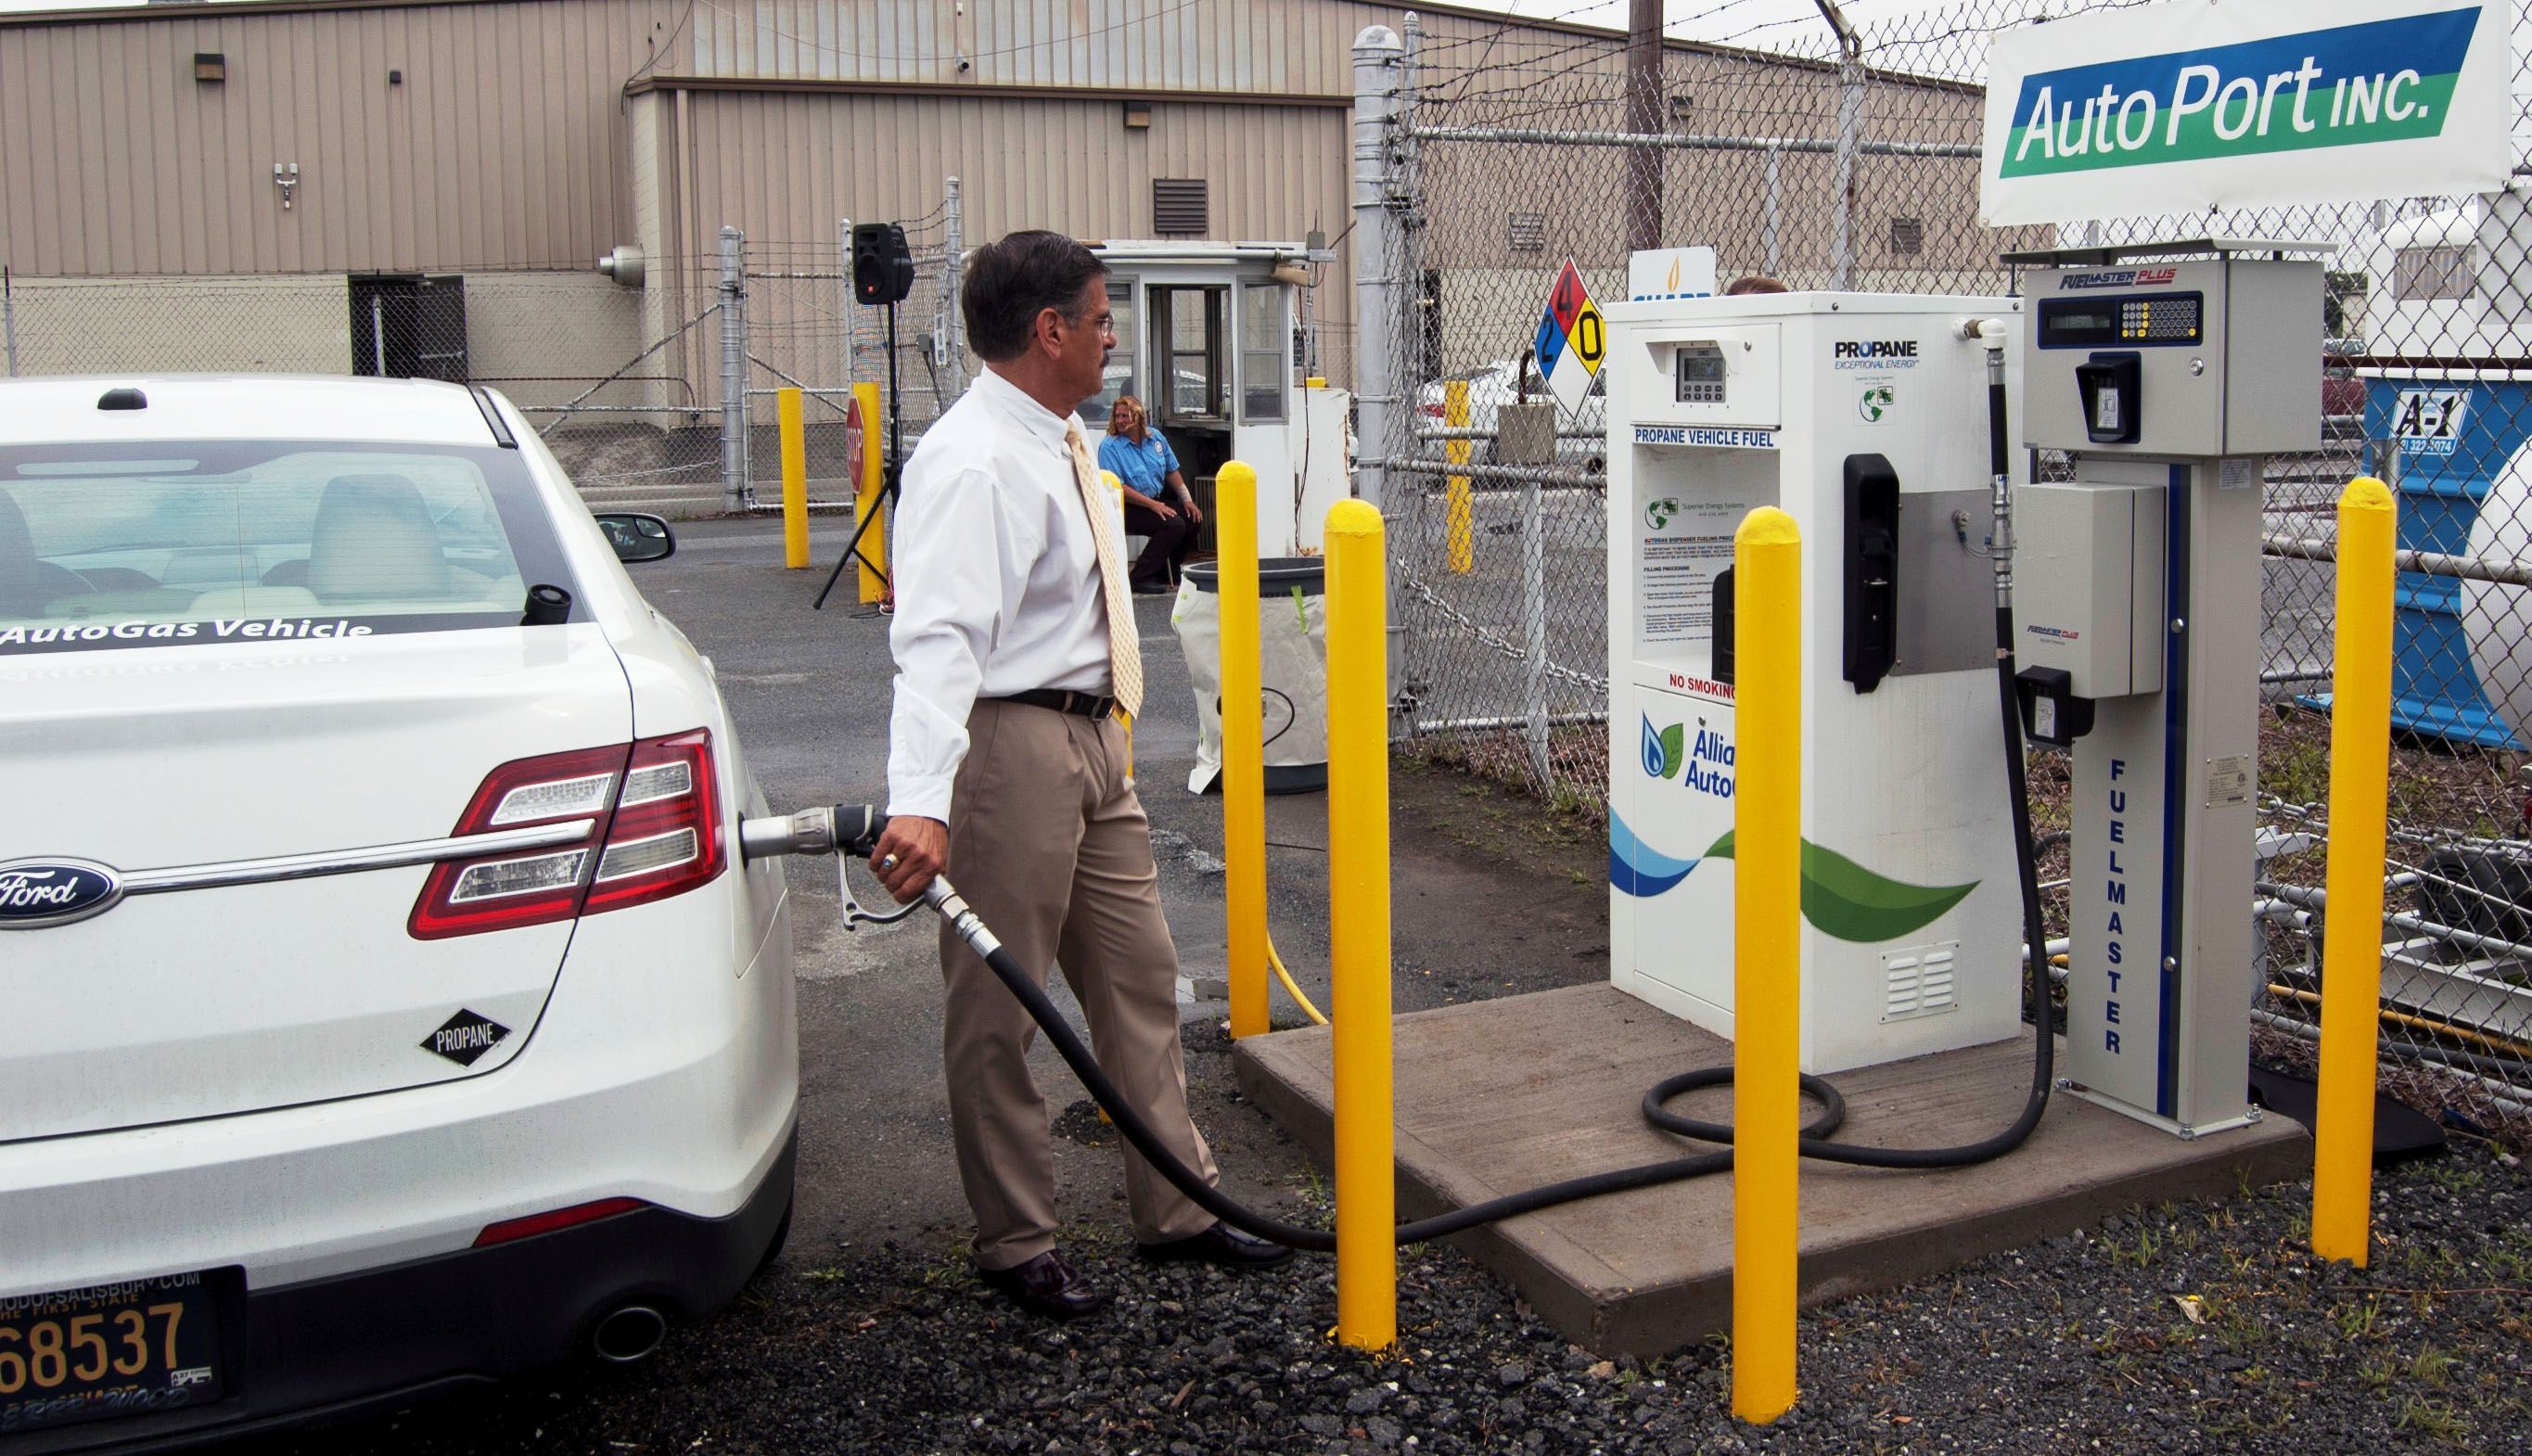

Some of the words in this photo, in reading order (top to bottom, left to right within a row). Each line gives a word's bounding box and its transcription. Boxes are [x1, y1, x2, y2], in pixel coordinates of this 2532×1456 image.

[2329, 69, 2429, 128] INC.
[2136, 268, 2178, 283] PLUS
[1556, 271, 1573, 320] 4
[1541, 313, 1554, 363] 2
[1579, 311, 1603, 362] 0
[1835, 340, 1918, 359] PROPANE
[1835, 361, 1885, 370] EXCEPTIONAL
[847, 428, 863, 462] STOP
[1635, 428, 1685, 443] PROPANE
[1689, 429, 1739, 446] VEHICLE
[1743, 431, 1774, 447] FUEL
[0, 619, 198, 645] AutoGas
[212, 618, 373, 639] Vehicle
[1669, 673, 1685, 688] NO
[1684, 760, 1735, 798] Auto
[0, 870, 79, 906] Ford
[2105, 759, 2126, 1055] FUELMASTER
[436, 1022, 495, 1054] PROPANE
[0, 1301, 184, 1395] 68537
